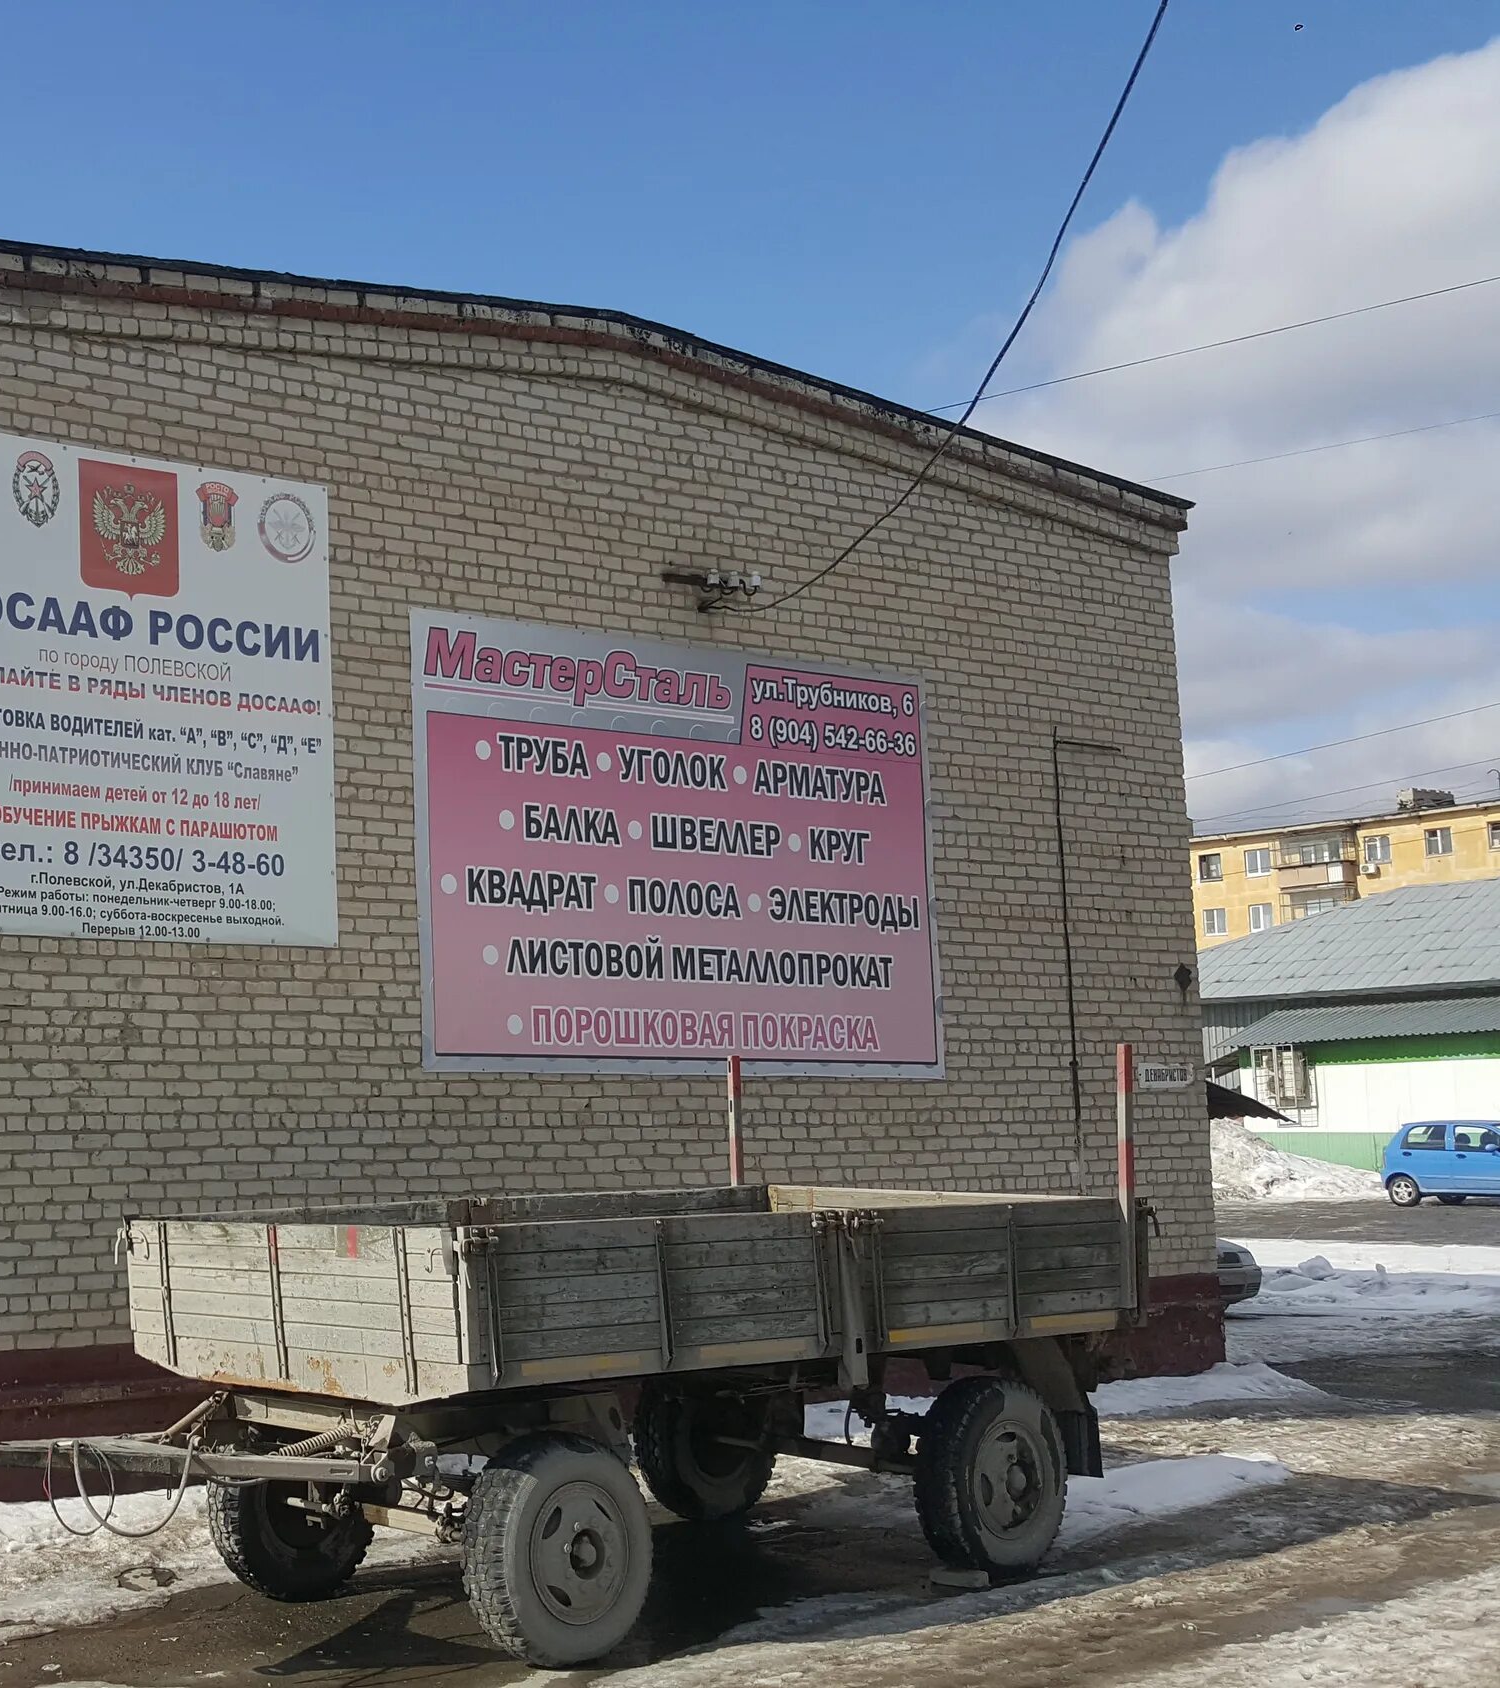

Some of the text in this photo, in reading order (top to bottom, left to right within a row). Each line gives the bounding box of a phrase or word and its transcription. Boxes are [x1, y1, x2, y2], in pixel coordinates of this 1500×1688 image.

[149, 609, 320, 663] РОССИИ
[39, 649, 231, 682] по городу ПОЛЕВСКОЙ
[424, 626, 732, 711] МастерСталь
[68, 674, 80, 692] В
[87, 678, 146, 701] РЯДЫ
[152, 684, 231, 709] ЧЛЕНОВ
[237, 693, 321, 715] ДОСААФ!
[751, 677, 914, 718] ул.Трубников, 6
[50, 709, 144, 740] ВОДИТЕЛЕЙ
[148, 728, 176, 742] кат.
[750, 716, 916, 757] 8 (904) 542-66-36
[186, 757, 223, 777] КЛУБ
[498, 734, 886, 805] ТРУБА УГОЛОК АРМАТУРА
[9, 774, 260, 811] /принимаем детей от 12 до 18 лет/
[80, 812, 161, 835] ПРЫЖКАМ
[166, 819, 175, 836] С
[180, 819, 277, 841] ПАРАШЮТОМ
[523, 804, 871, 865] БАЛКА ШВЕЛЛЕР КРУГ
[63, 841, 79, 865] 8
[88, 841, 183, 872] /34350/
[192, 849, 285, 877] 3-48-60
[31, 872, 244, 898] г.Полевской, ул.Декабристов, 1А
[40, 888, 89, 904] работы:
[93, 893, 216, 913] понедельник-четверг
[466, 867, 920, 932] КВАДРАТ ПОЛОСА ЭЛЕКТРОДЫ
[82, 922, 200, 939] Перерыв 12.00-13.00
[100, 909, 223, 926] суббота-воскресенье
[226, 915, 284, 928] выходной.
[506, 937, 892, 990] ЛИСТОВОЙ МЕТАЛЛОПРОКАТ
[531, 1006, 880, 1052] ПОРОШКОВАЯ ПОКРАСКА
[1145, 1069, 1188, 1082] ДЕКАБРИСТОВ
